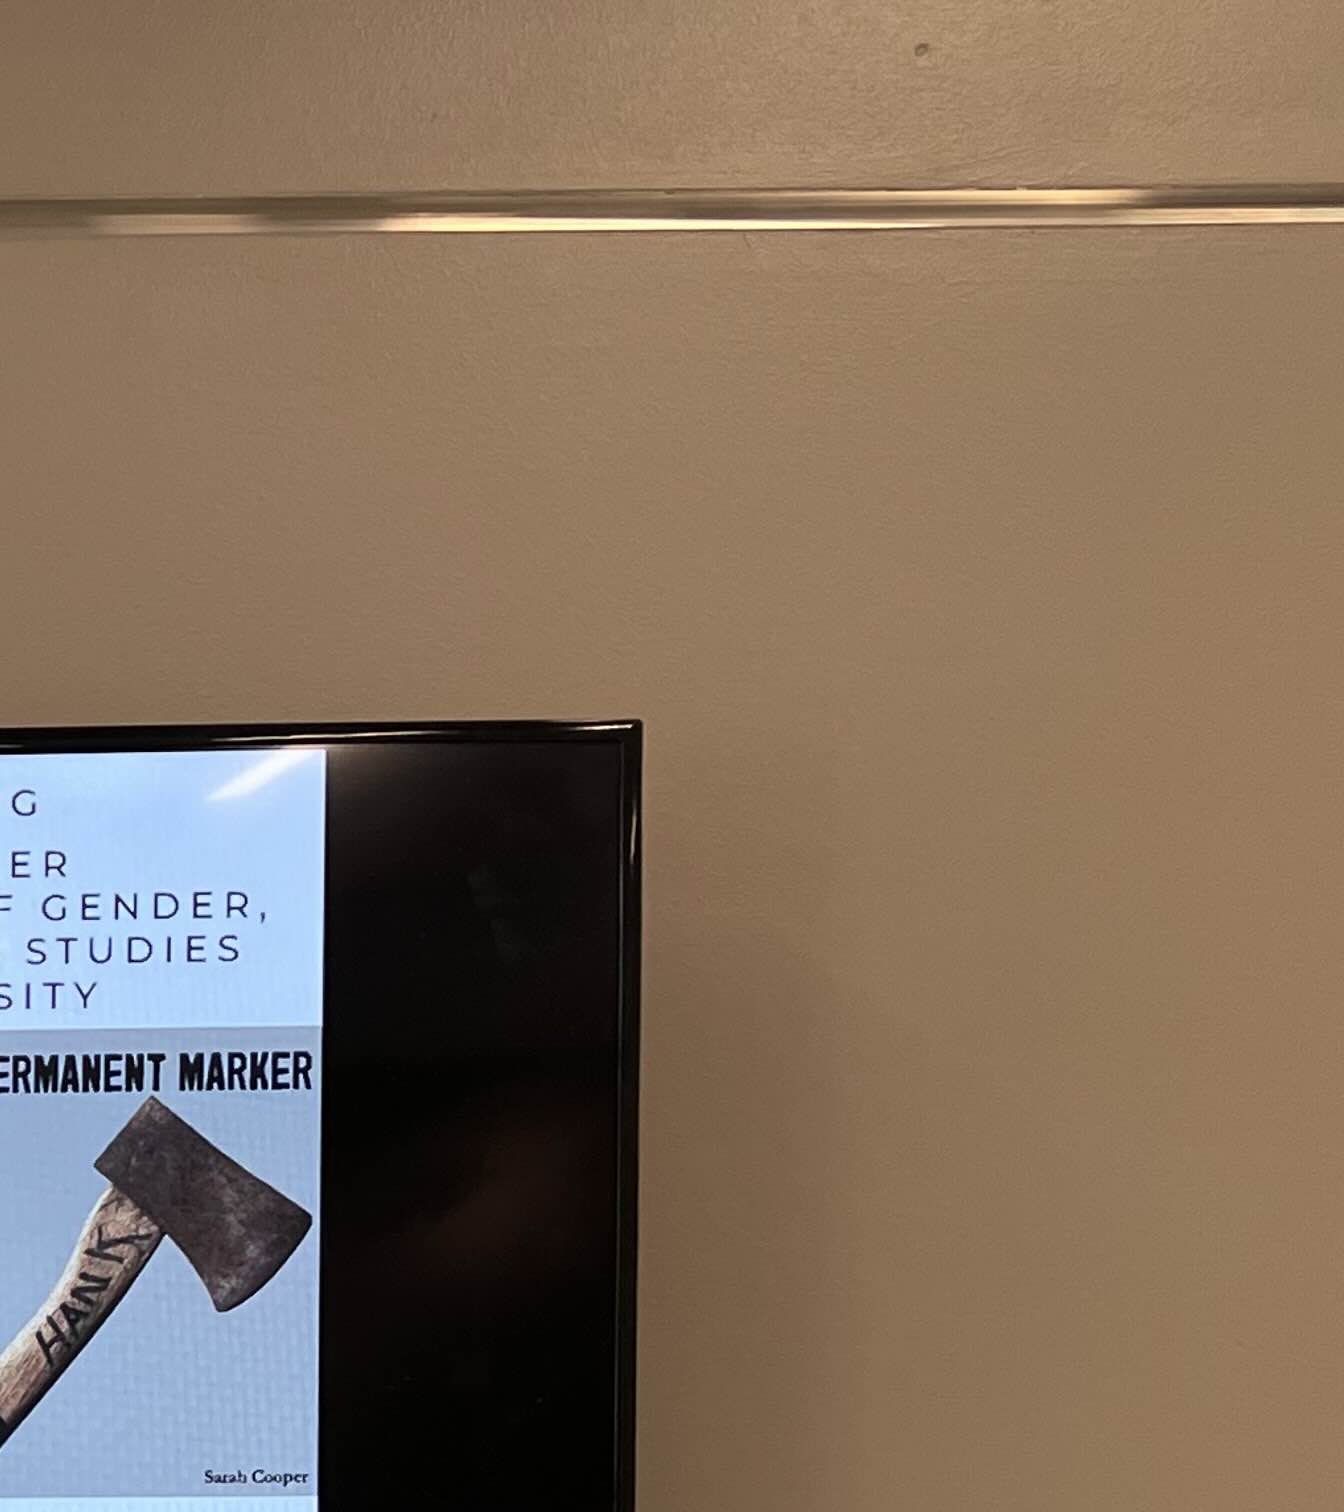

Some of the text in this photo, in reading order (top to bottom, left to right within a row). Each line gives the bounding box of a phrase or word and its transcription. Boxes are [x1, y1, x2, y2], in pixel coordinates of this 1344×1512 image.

[42, 892, 265, 923] GENDER,
[27, 935, 238, 965] STUDIES
[179, 1051, 312, 1091] MARKER
[34, 1224, 155, 1368] HANK
[205, 1469, 308, 1487] Sarah Cooper
